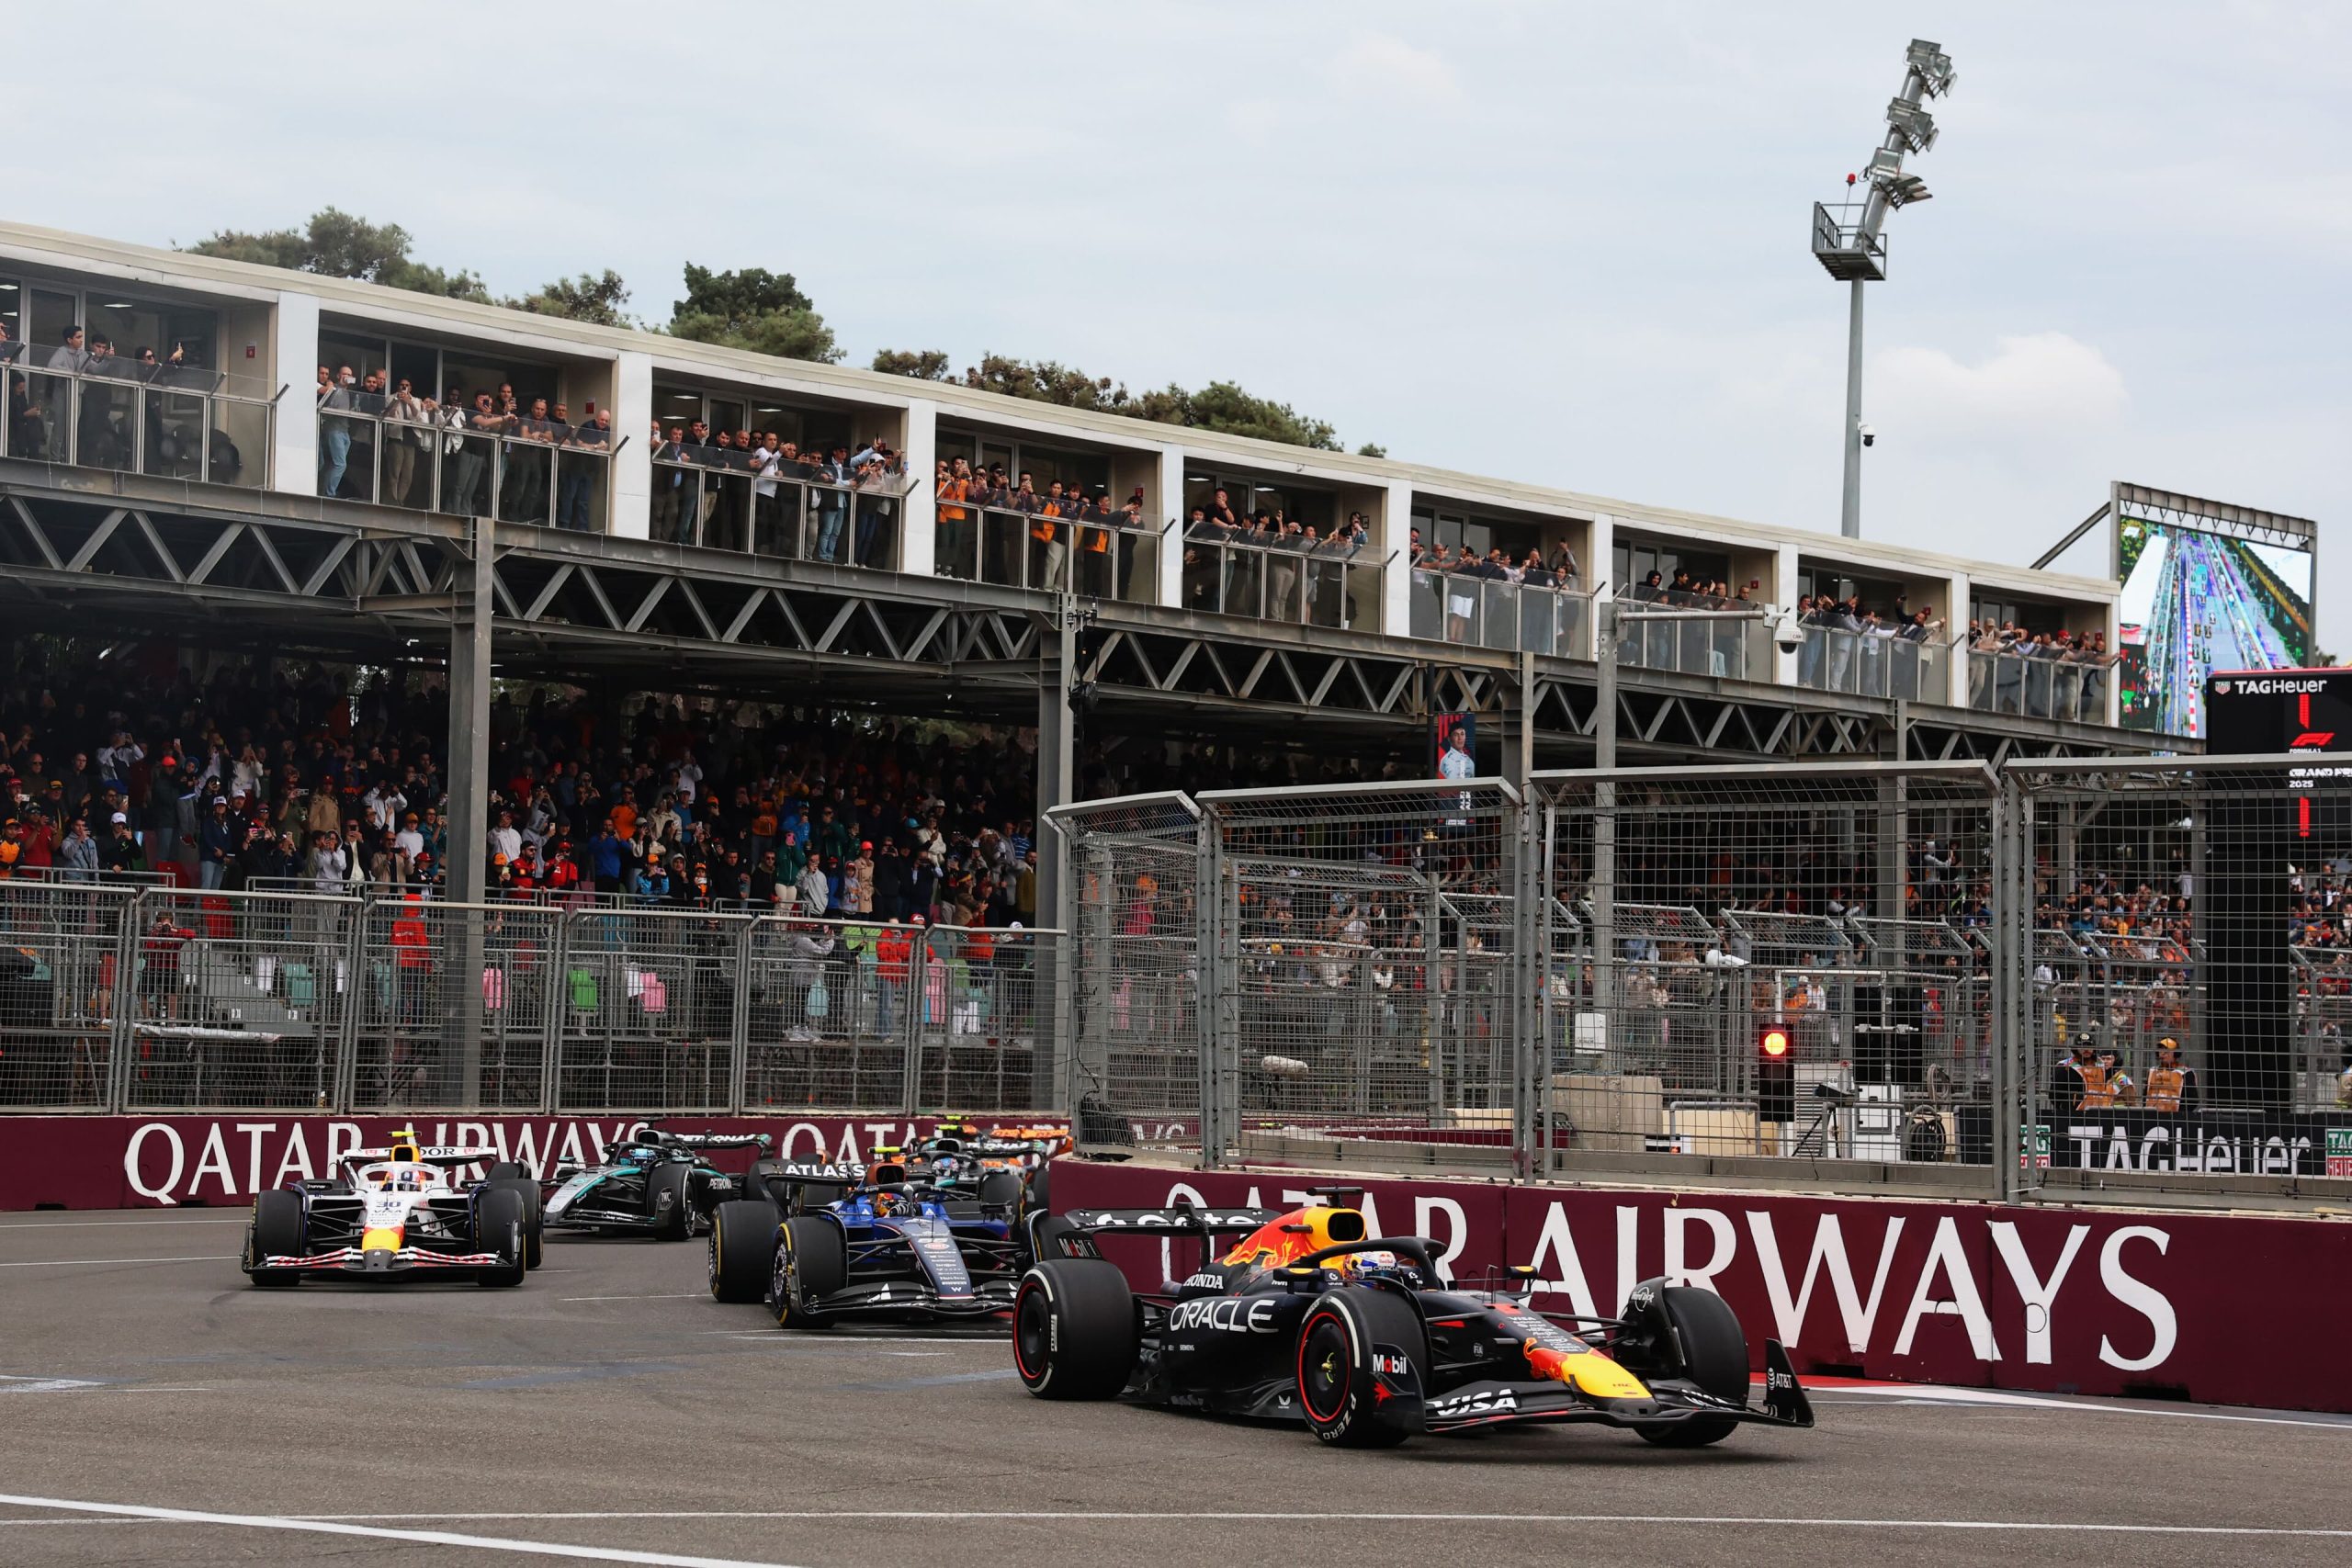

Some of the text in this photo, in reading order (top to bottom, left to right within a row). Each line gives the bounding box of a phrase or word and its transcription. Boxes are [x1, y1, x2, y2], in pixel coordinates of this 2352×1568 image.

[2289, 768, 2334, 778] GRAND
[2289, 780, 2314, 788] 2025
[384, 1147, 456, 1156] TDOR
[124, 1122, 649, 1205] QATAR IRWAY
[785, 1163, 870, 1177] ATLASS
[1058, 1237, 1088, 1258] Mobil
[1183, 1273, 1224, 1290] HONDA
[1516, 1201, 2177, 1371] AIRWAYS
[1170, 1299, 1279, 1334] ORACLE
[1373, 1354, 1407, 1375] Mobil
[1775, 1372, 1792, 1389] AT&T
[1425, 1388, 1518, 1416] VISA
[1322, 1410, 1351, 1440] ZERO
